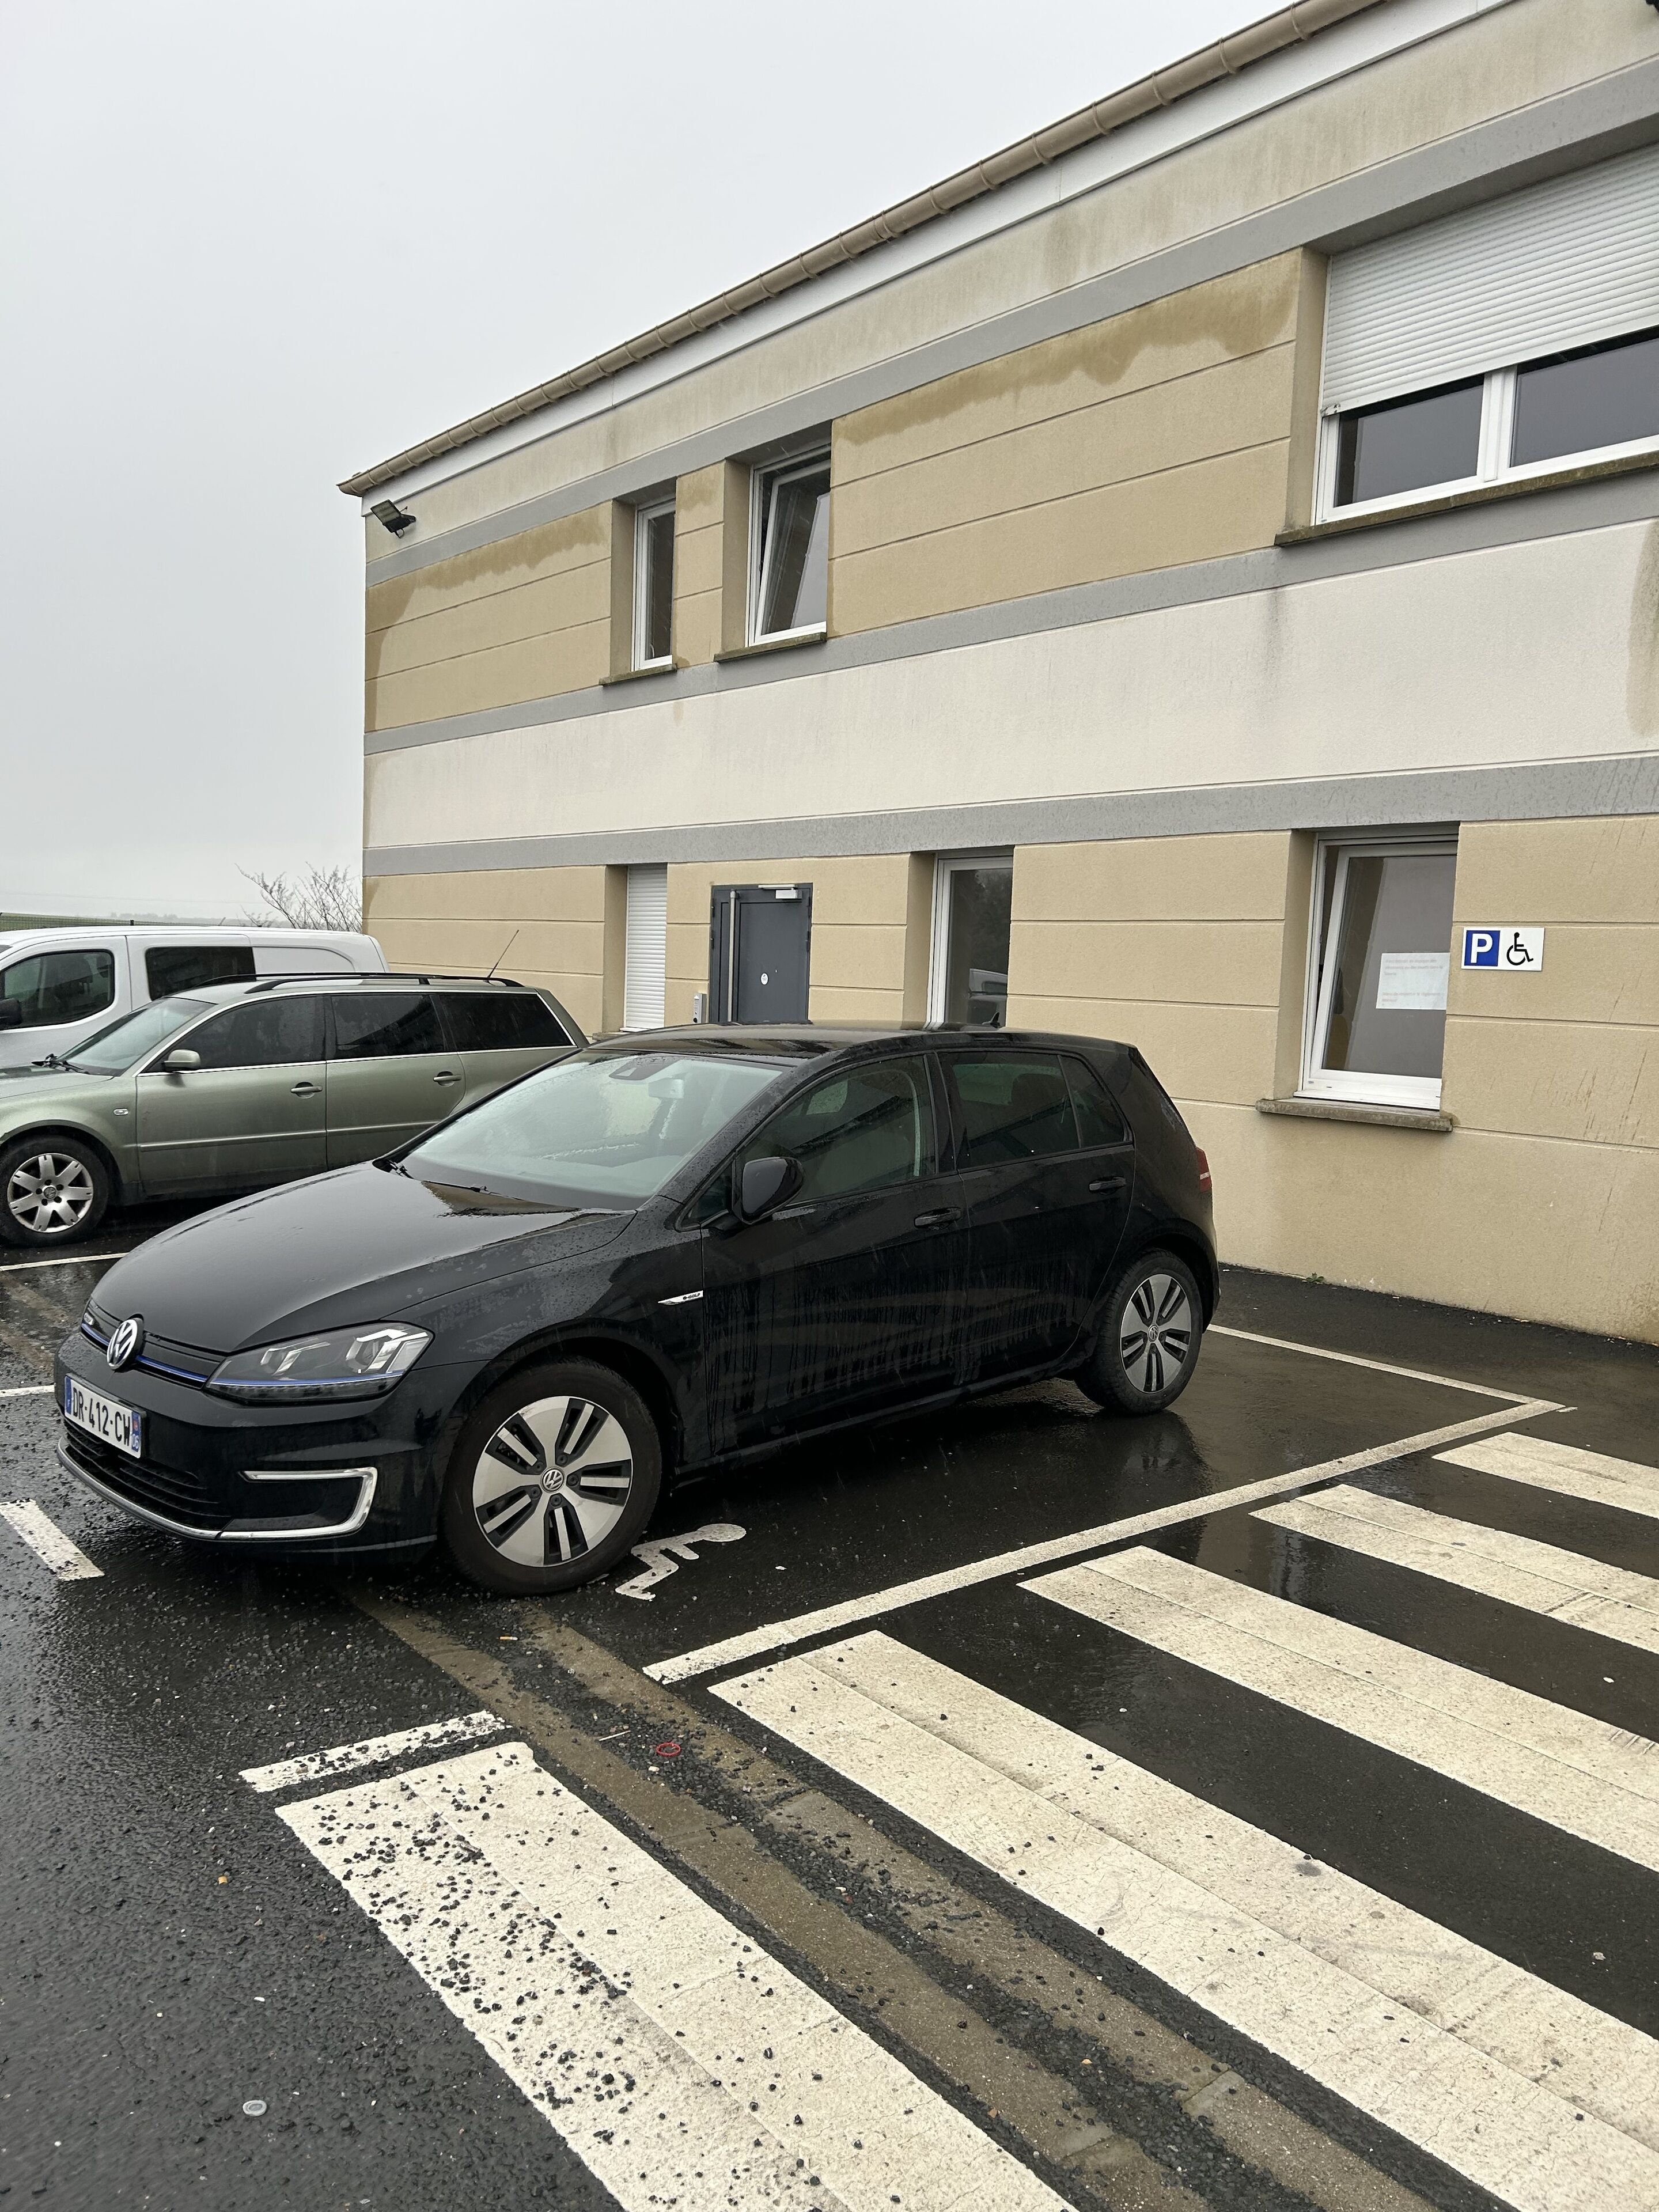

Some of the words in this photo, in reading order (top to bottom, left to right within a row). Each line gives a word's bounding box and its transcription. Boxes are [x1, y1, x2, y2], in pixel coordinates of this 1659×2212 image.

[1471, 933, 1493, 963] P
[107, 1319, 138, 1369] VW
[73, 1387, 130, 1446] DR-412-CW
